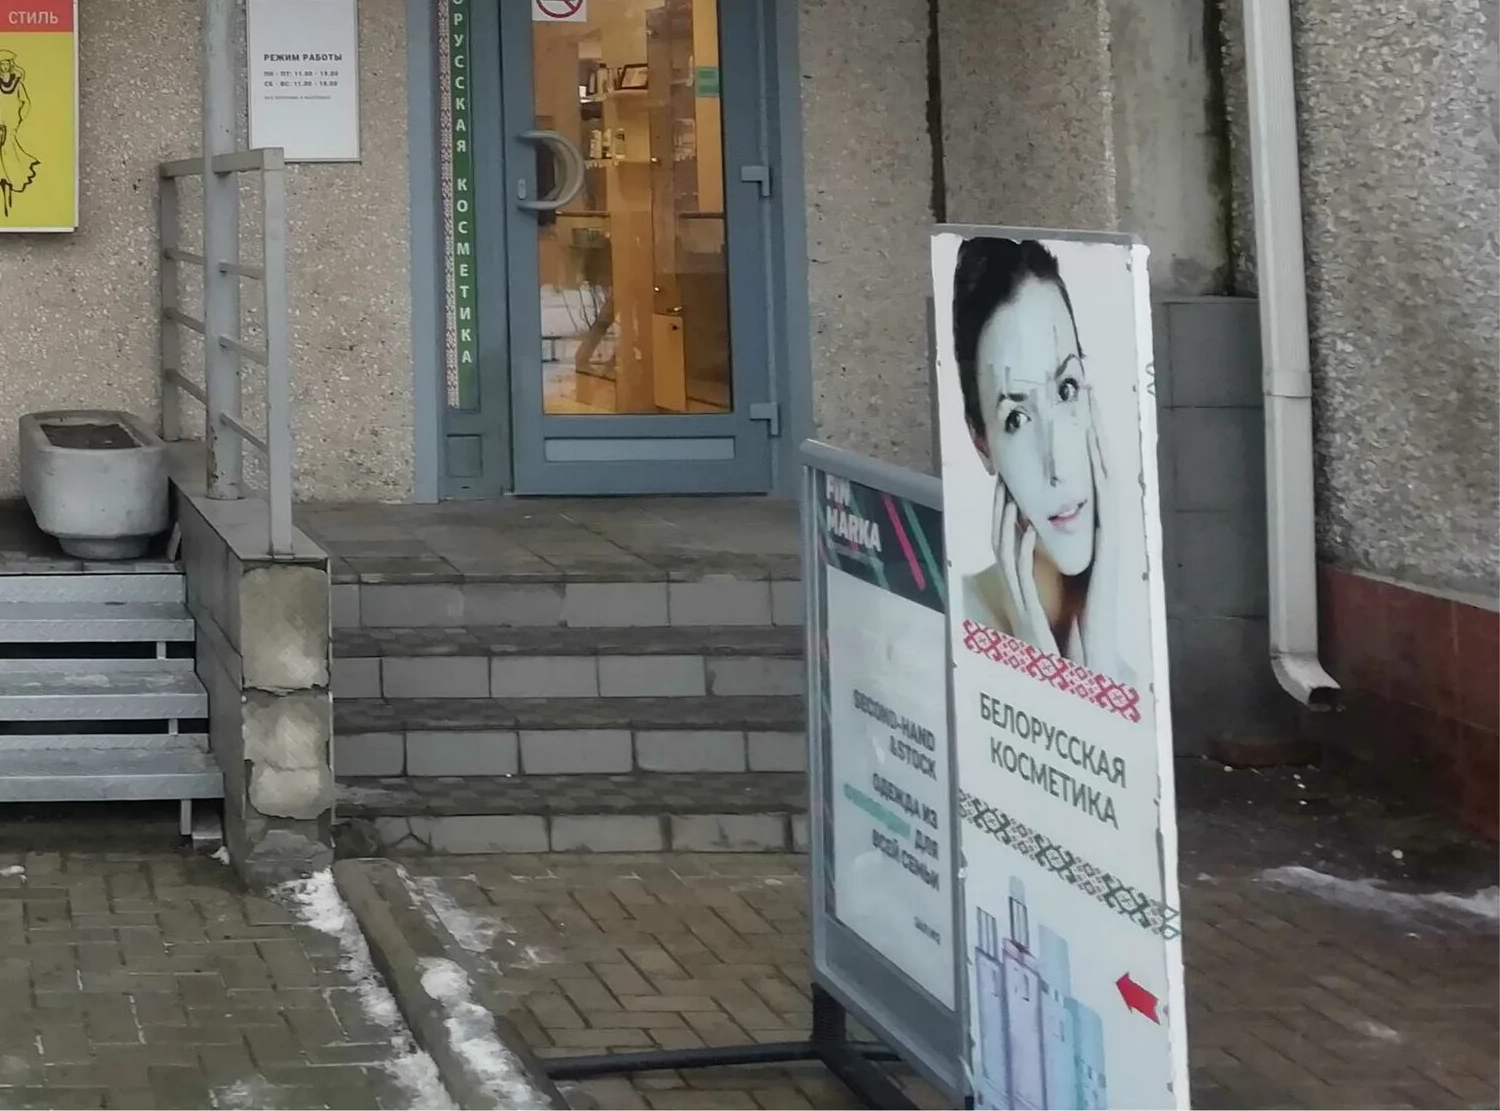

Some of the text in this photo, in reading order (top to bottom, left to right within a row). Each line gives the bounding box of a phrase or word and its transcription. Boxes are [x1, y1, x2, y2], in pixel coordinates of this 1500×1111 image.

[263, 53, 343, 62] РЕЖИМ РАБОТЫ
[456, 178, 472, 363] КОСМЕТИКА
[826, 505, 882, 552] MARKA
[980, 692, 1127, 788] БЕЛОРУССКАЯ
[990, 736, 1119, 830] КОСМЕТИКА
